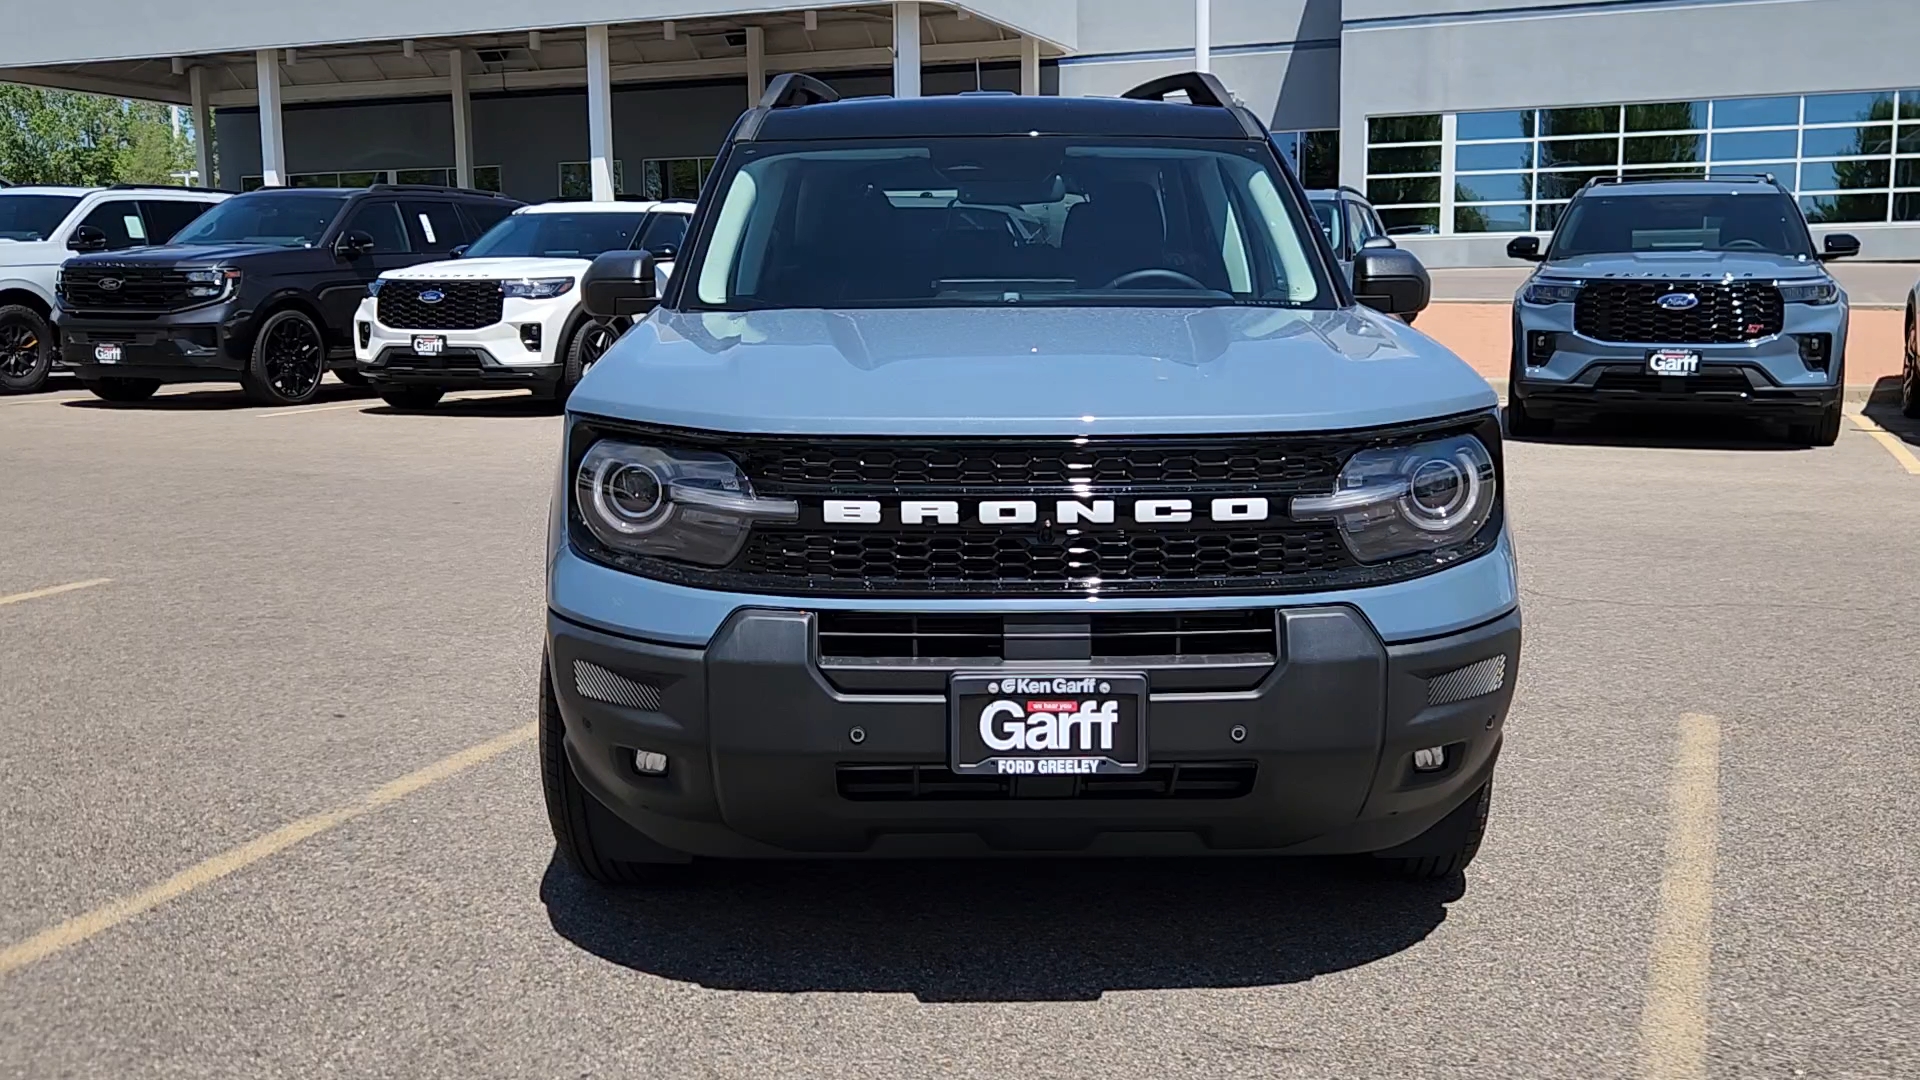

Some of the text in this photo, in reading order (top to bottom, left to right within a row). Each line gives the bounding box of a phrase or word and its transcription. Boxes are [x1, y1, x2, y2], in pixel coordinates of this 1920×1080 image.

[413, 338, 443, 353] Garff
[1650, 353, 1699, 371] Garff
[823, 497, 1269, 524] BRONCO
[1017, 678, 1097, 694] Ken Garff
[979, 700, 1118, 751] Garff
[998, 759, 1100, 774] FORD GREELEY
